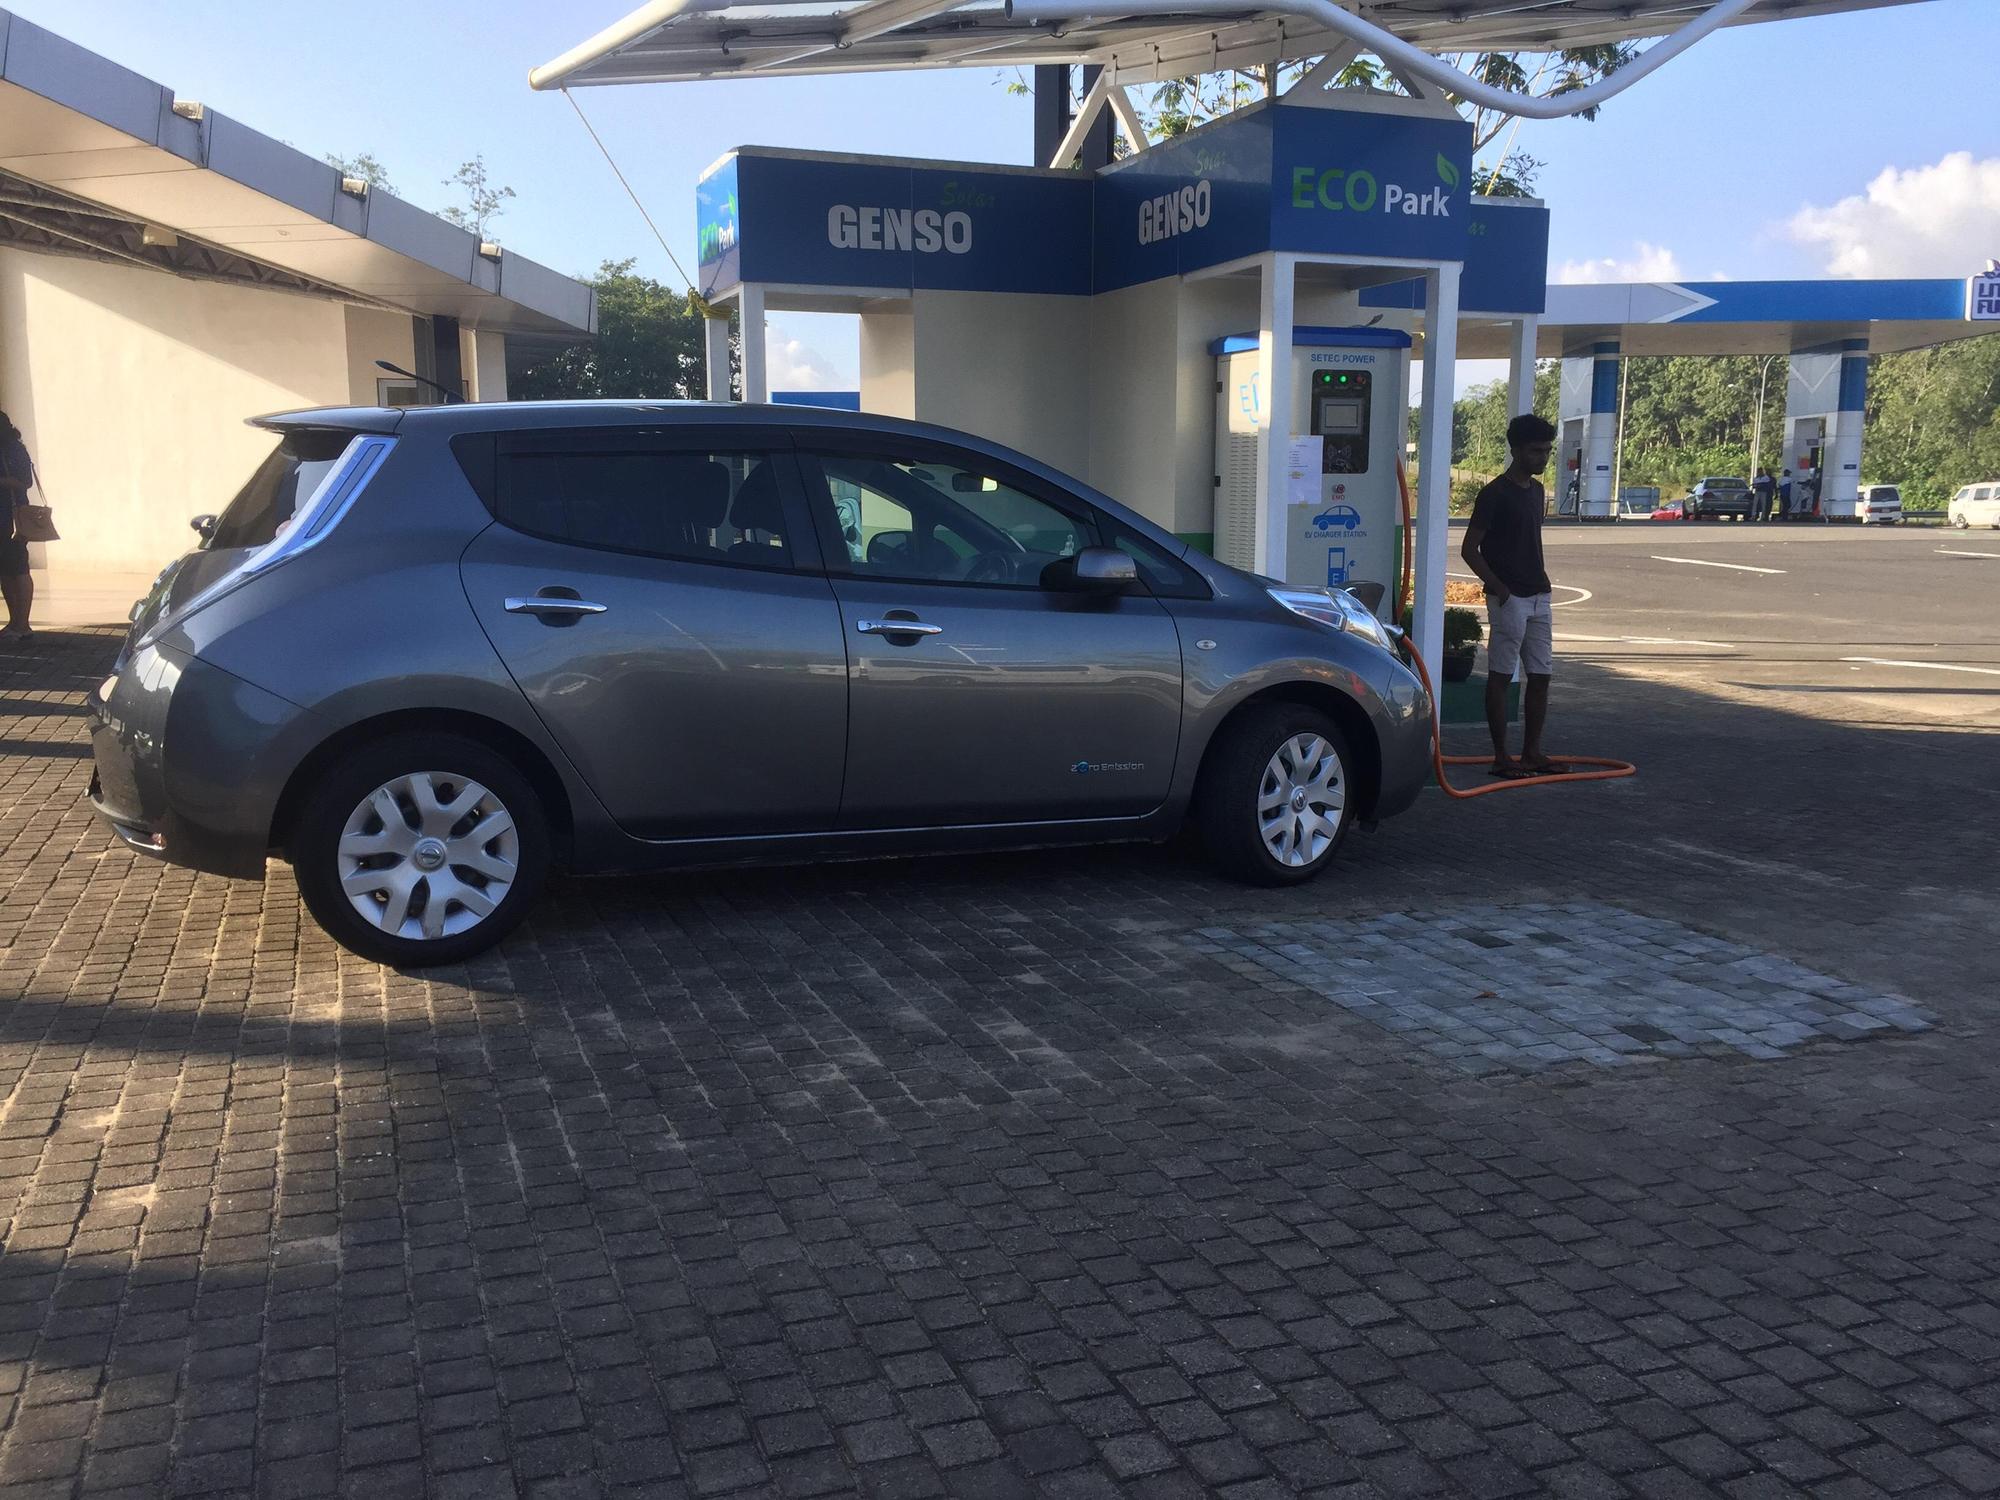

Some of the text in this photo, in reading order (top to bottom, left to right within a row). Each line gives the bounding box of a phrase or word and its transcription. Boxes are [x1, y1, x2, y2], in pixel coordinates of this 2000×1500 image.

[1293, 167, 1449, 216] ECO Park
[827, 204, 973, 255] GENSO
[1139, 180, 1211, 245] GENSO
[701, 220, 735, 260] ECO Park
[1310, 353, 1376, 364] SETEC POWER
[1304, 531, 1313, 539] EV
[1343, 530, 1368, 538] STATION
[1332, 573, 1340, 585] E
